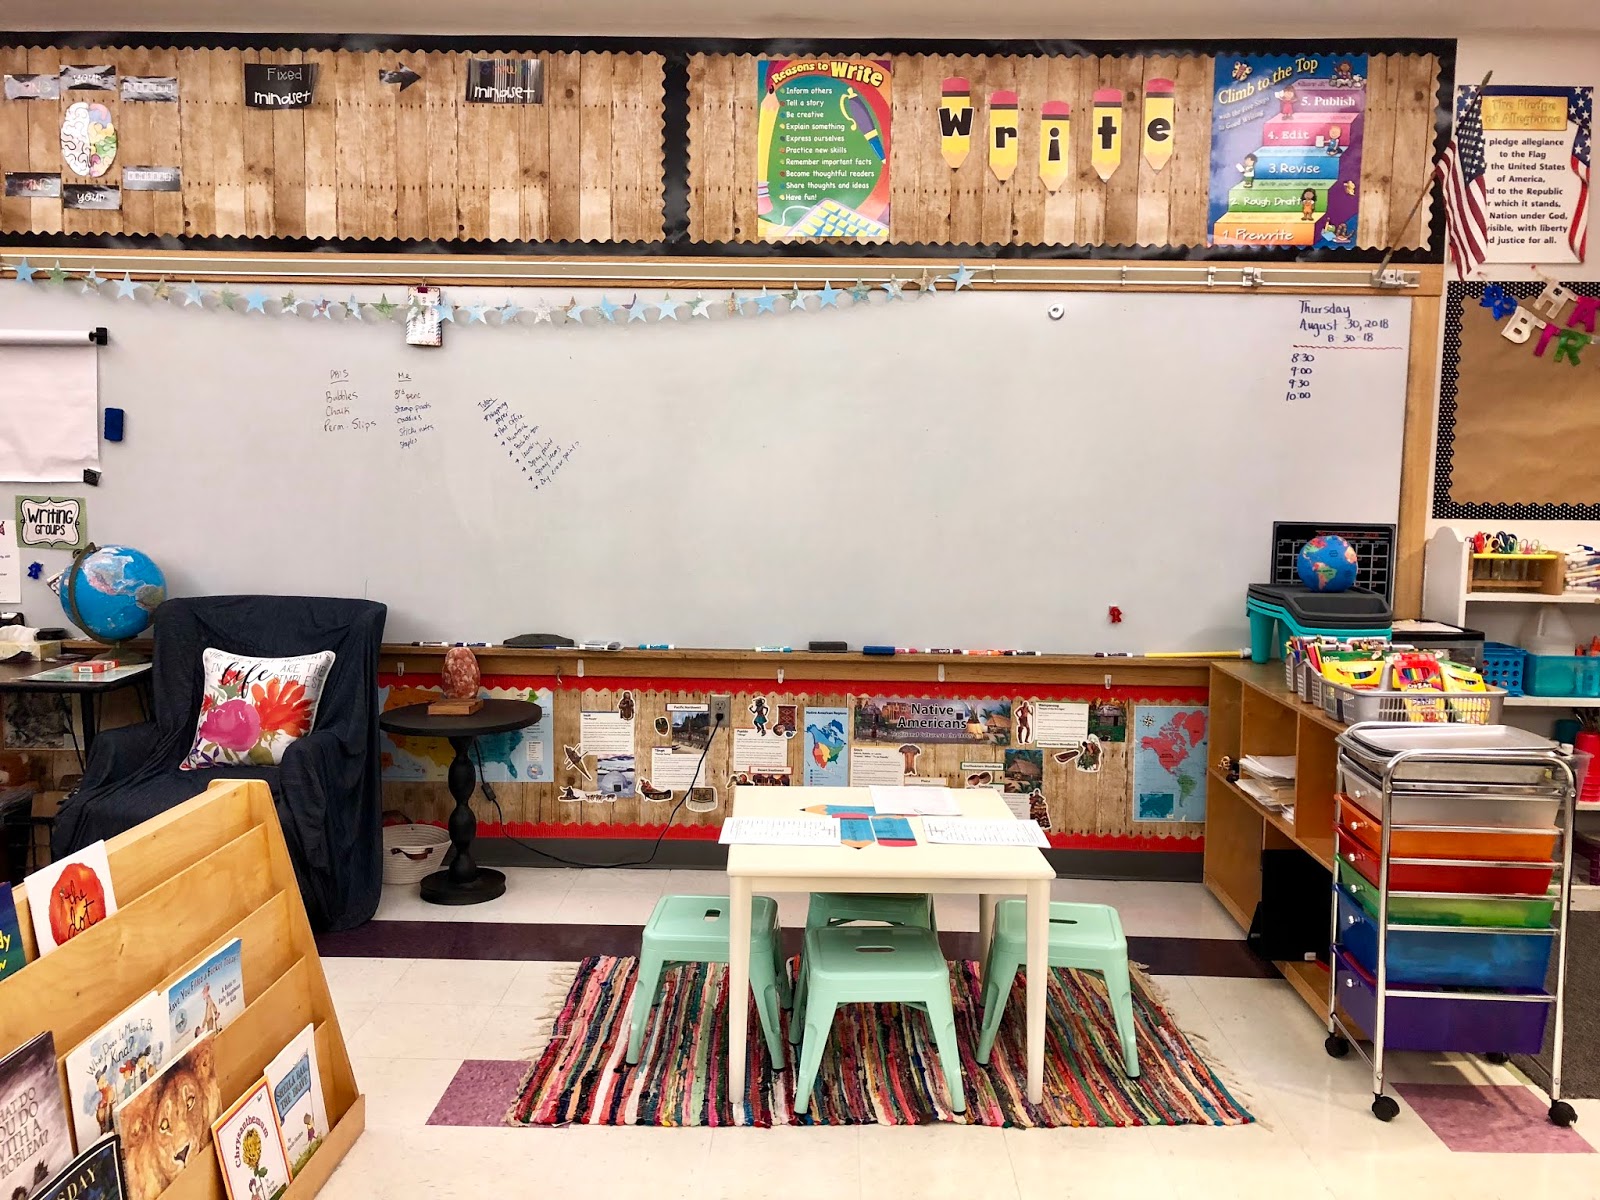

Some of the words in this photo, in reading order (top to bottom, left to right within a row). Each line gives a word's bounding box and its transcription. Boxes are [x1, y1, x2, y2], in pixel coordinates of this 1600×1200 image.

[267, 67, 302, 81] Fixed
[771, 61, 815, 84] Reasons
[817, 62, 829, 71] to
[830, 61, 884, 87] Write
[1218, 84, 1254, 104] Climb
[1258, 77, 1270, 91] to
[1272, 65, 1292, 83] the
[1295, 57, 1318, 73] Top
[254, 91, 311, 105] mindset
[474, 86, 535, 99] mindset
[806, 100, 824, 108] story
[1300, 96, 1311, 106] 5.
[1314, 96, 1356, 106] Publish
[1491, 100, 1514, 110] The
[1518, 99, 1556, 112] Pledge
[1242, 104, 1254, 113] Five
[1226, 119, 1241, 129] Good
[1486, 114, 1499, 124] of
[1502, 113, 1560, 126] Allegiance
[786, 123, 810, 132] Explain
[812, 123, 845, 132] something
[786, 135, 812, 143] Express
[1268, 130, 1278, 140] 4.
[1282, 130, 1310, 140] Edit
[1489, 138, 1518, 148] pledge
[1521, 138, 1564, 148] allegiance
[786, 146, 812, 154] Practice
[1511, 150, 1526, 158] the
[1528, 150, 1546, 160] Flag
[786, 158, 819, 166] Remember
[822, 158, 852, 167] important
[855, 158, 872, 166] facts
[1268, 163, 1278, 174] 3.
[1280, 163, 1320, 174] Revise
[812, 170, 847, 178] thoughtful
[1496, 175, 1506, 183] of
[1508, 175, 1546, 184] America,
[807, 182, 836, 190] thoughts
[1510, 187, 1524, 195] the
[1526, 187, 1564, 197] Republic
[77, 192, 105, 204] your
[1230, 196, 1240, 206] 2.
[1243, 196, 1271, 207] Rough
[1274, 196, 1302, 206] Draft
[1489, 212, 1518, 220] Nation
[1520, 212, 1546, 220] under
[1548, 212, 1568, 221] God,
[1236, 229, 1294, 241] Prewrite
[1517, 224, 1537, 232] with
[1540, 224, 1568, 234] liberty
[1497, 236, 1526, 246] justice
[1528, 236, 1540, 244] for
[1544, 236, 1557, 244] all.
[1299, 300, 1350, 318] Thursday
[1300, 318, 1338, 338] August
[325, 390, 358, 404] Bubbles
[351, 417, 377, 432] Slips
[210, 662, 221, 673] IN
[280, 663, 300, 674] ARE
[307, 662, 326, 679] THE
[273, 674, 322, 690] SIMPLEST
[910, 704, 954, 716] Native
[896, 716, 967, 729] Americans
[64, 880, 87, 905] the
[68, 899, 100, 940] dot
[102, 1038, 118, 1056] Does
[124, 1022, 139, 1039] Mean
[110, 1036, 135, 1066] Kind?
[19, 1086, 37, 1109] DO
[0, 1117, 16, 1143] OU
[19, 1101, 40, 1127] DO
[33, 1118, 42, 1136] A
[235, 1114, 269, 1168] Chrysanthemum
[0, 1129, 50, 1180] ROBLEM?
